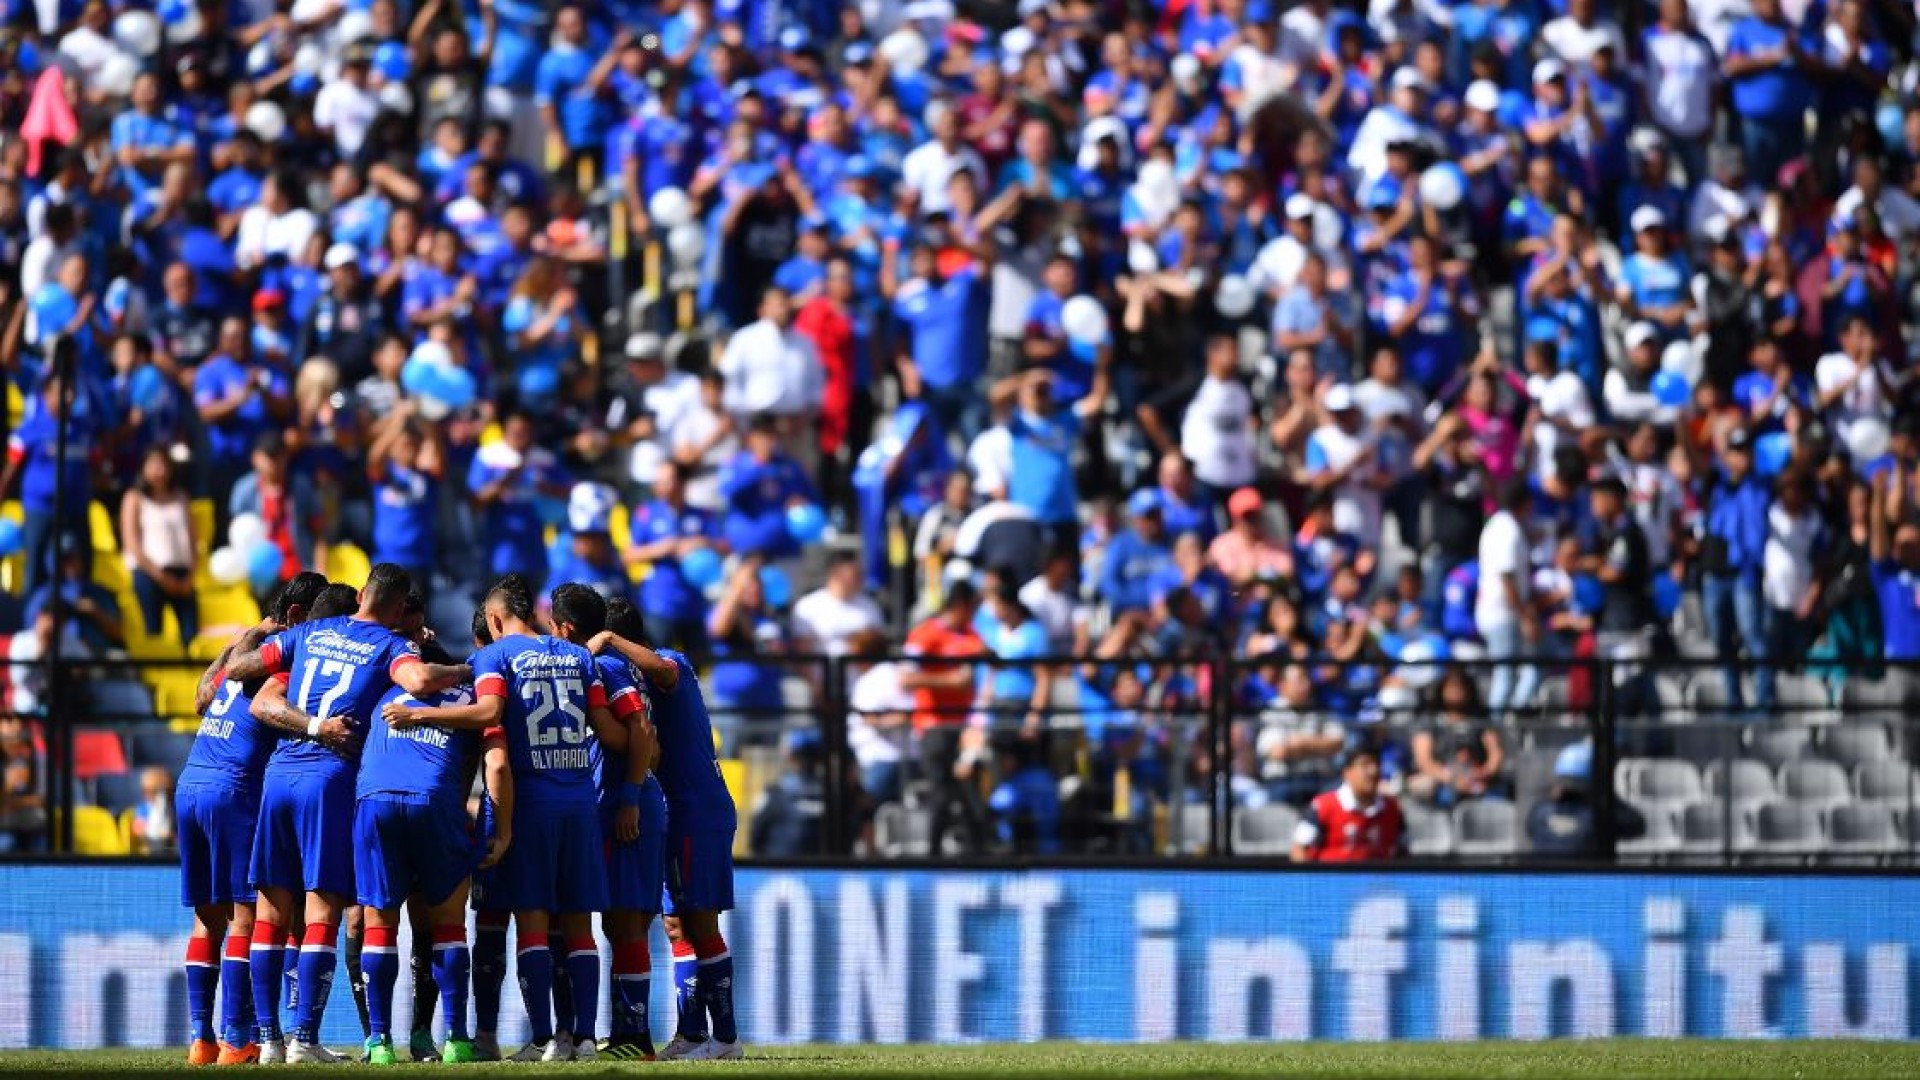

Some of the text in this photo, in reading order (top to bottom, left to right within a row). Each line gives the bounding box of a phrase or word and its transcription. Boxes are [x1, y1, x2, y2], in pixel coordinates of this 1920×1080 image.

[298, 658, 356, 719] 17
[521, 679, 586, 746] 25
[749, 875, 1063, 1043] ONET
